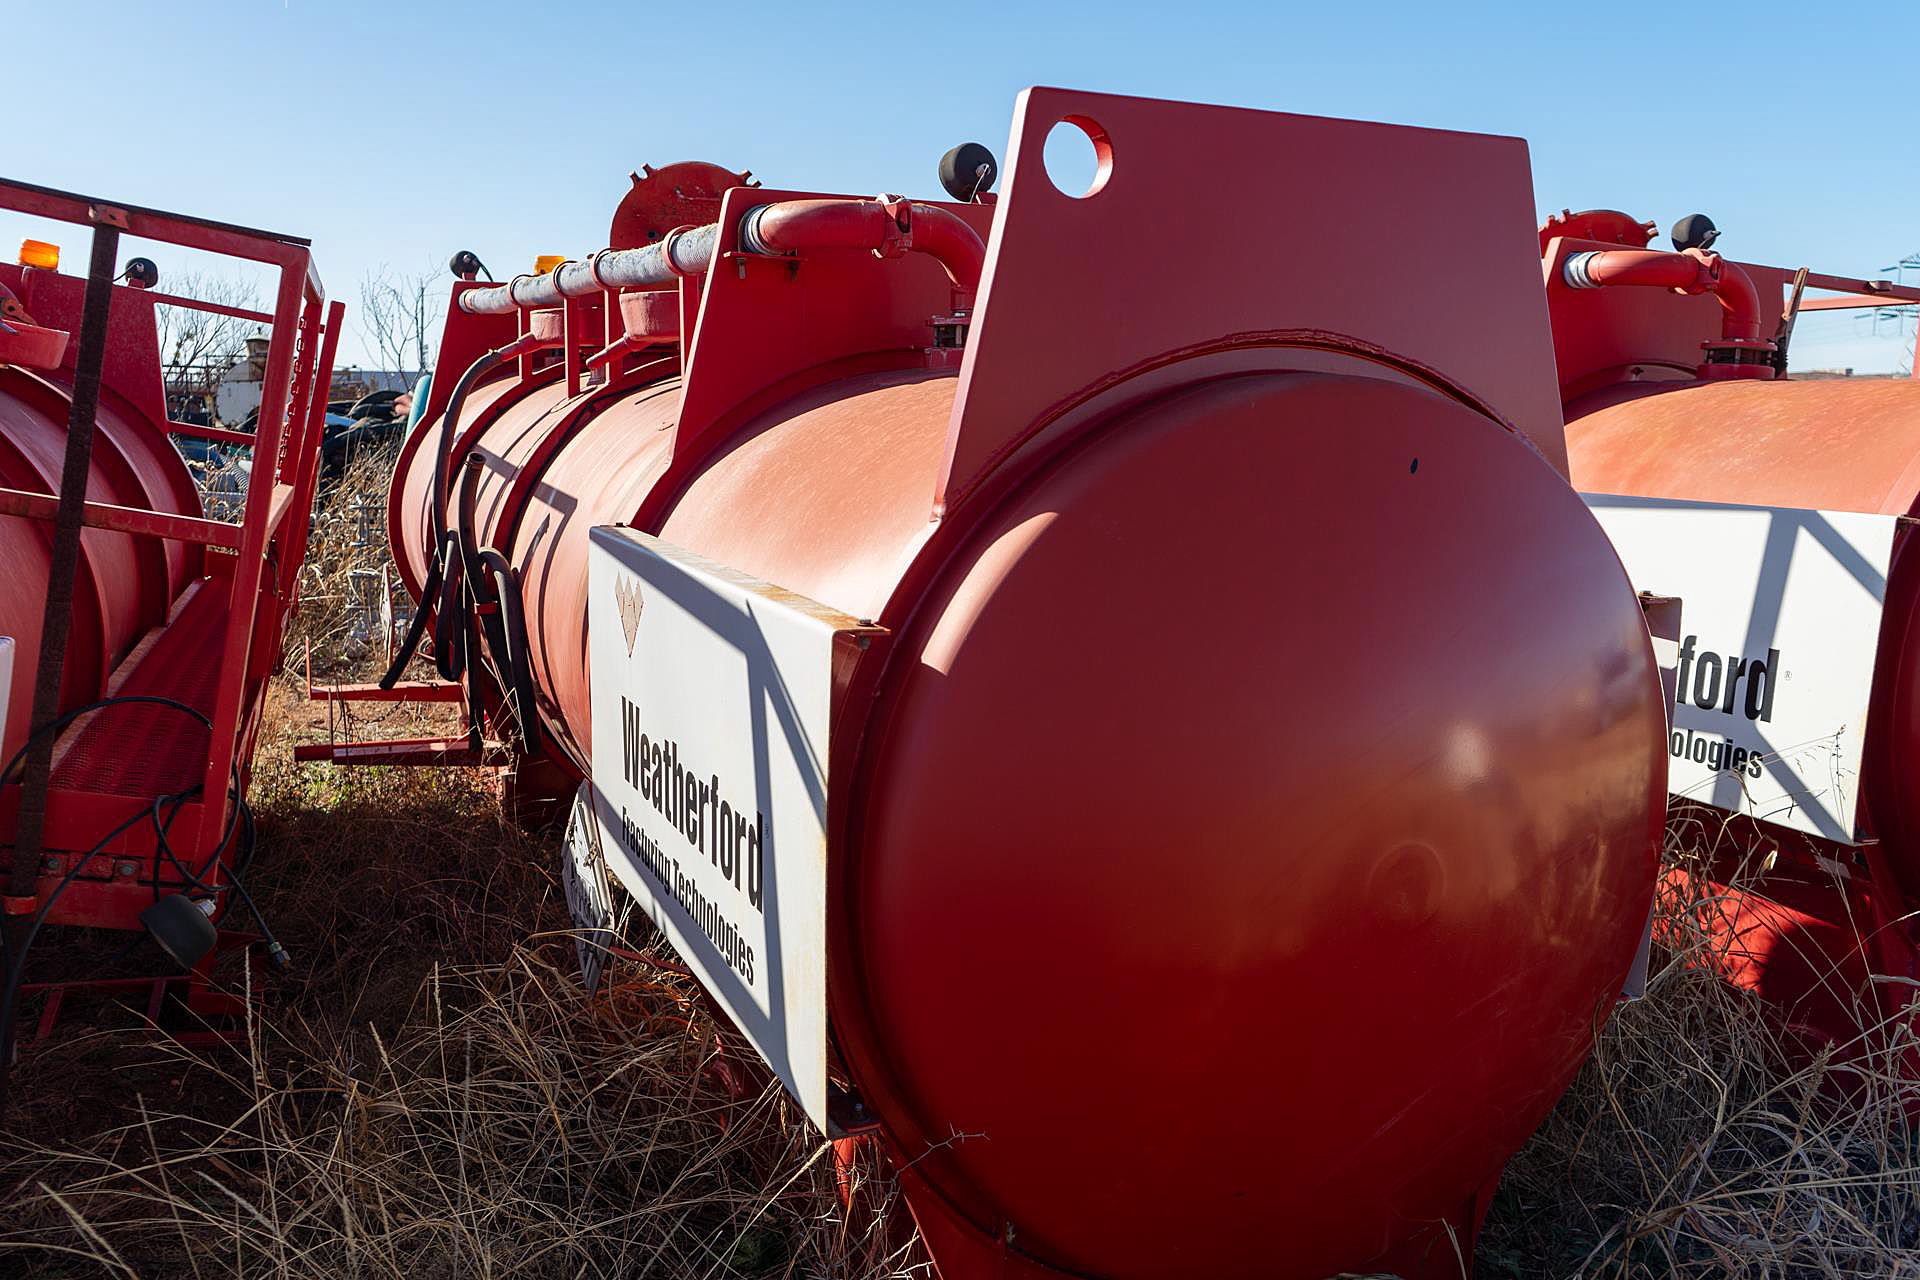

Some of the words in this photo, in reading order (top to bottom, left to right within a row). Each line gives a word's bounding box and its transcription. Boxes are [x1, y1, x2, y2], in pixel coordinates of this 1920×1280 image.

[621, 696, 763, 914] Weatherford
[622, 806, 671, 896] Fracturing
[673, 858, 754, 986] Technologies
